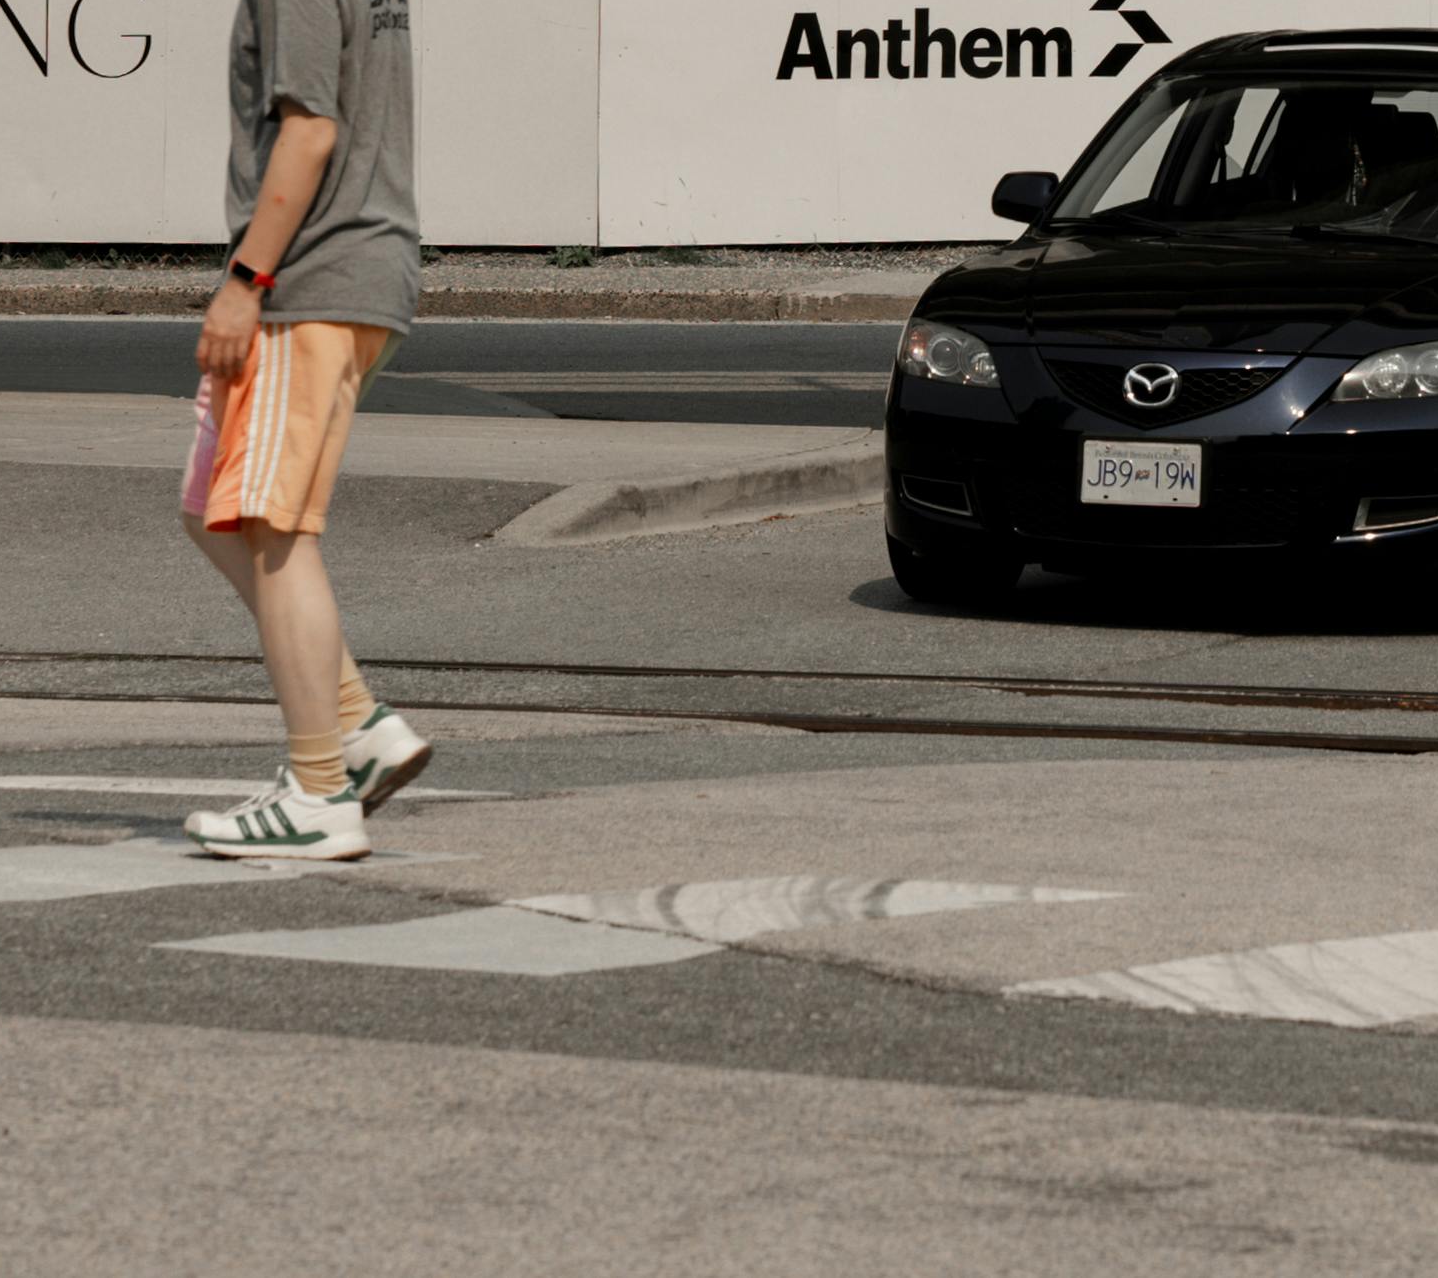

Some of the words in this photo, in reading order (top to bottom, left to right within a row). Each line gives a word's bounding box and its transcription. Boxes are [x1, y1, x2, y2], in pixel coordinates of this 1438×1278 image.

[775, 7, 1073, 81] Anthem
[1087, 459, 1133, 488] JB9
[1154, 461, 1195, 490] 19W
